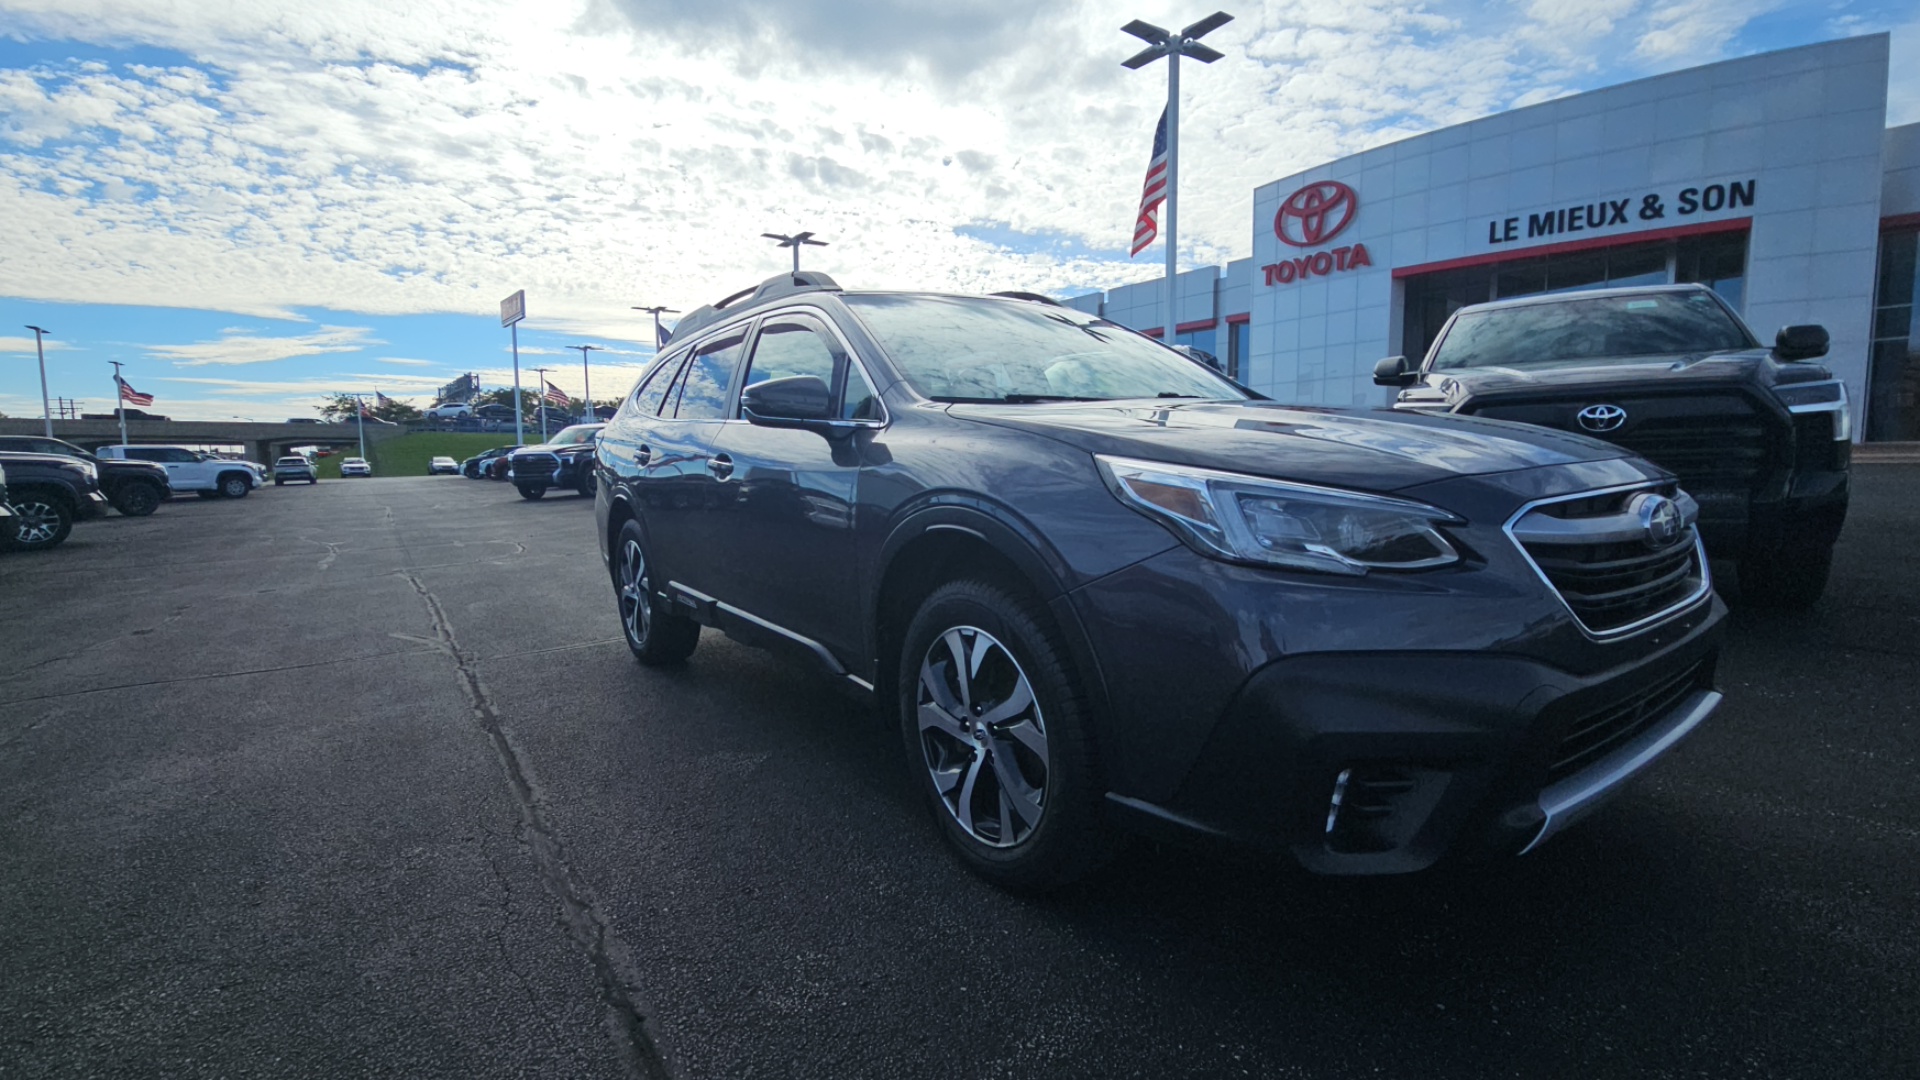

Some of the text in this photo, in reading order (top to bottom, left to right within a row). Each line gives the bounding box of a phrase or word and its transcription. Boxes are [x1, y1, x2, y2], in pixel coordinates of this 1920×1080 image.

[1489, 179, 1756, 244] LE MIEUX & SON
[1261, 243, 1371, 286] TOYOTA
